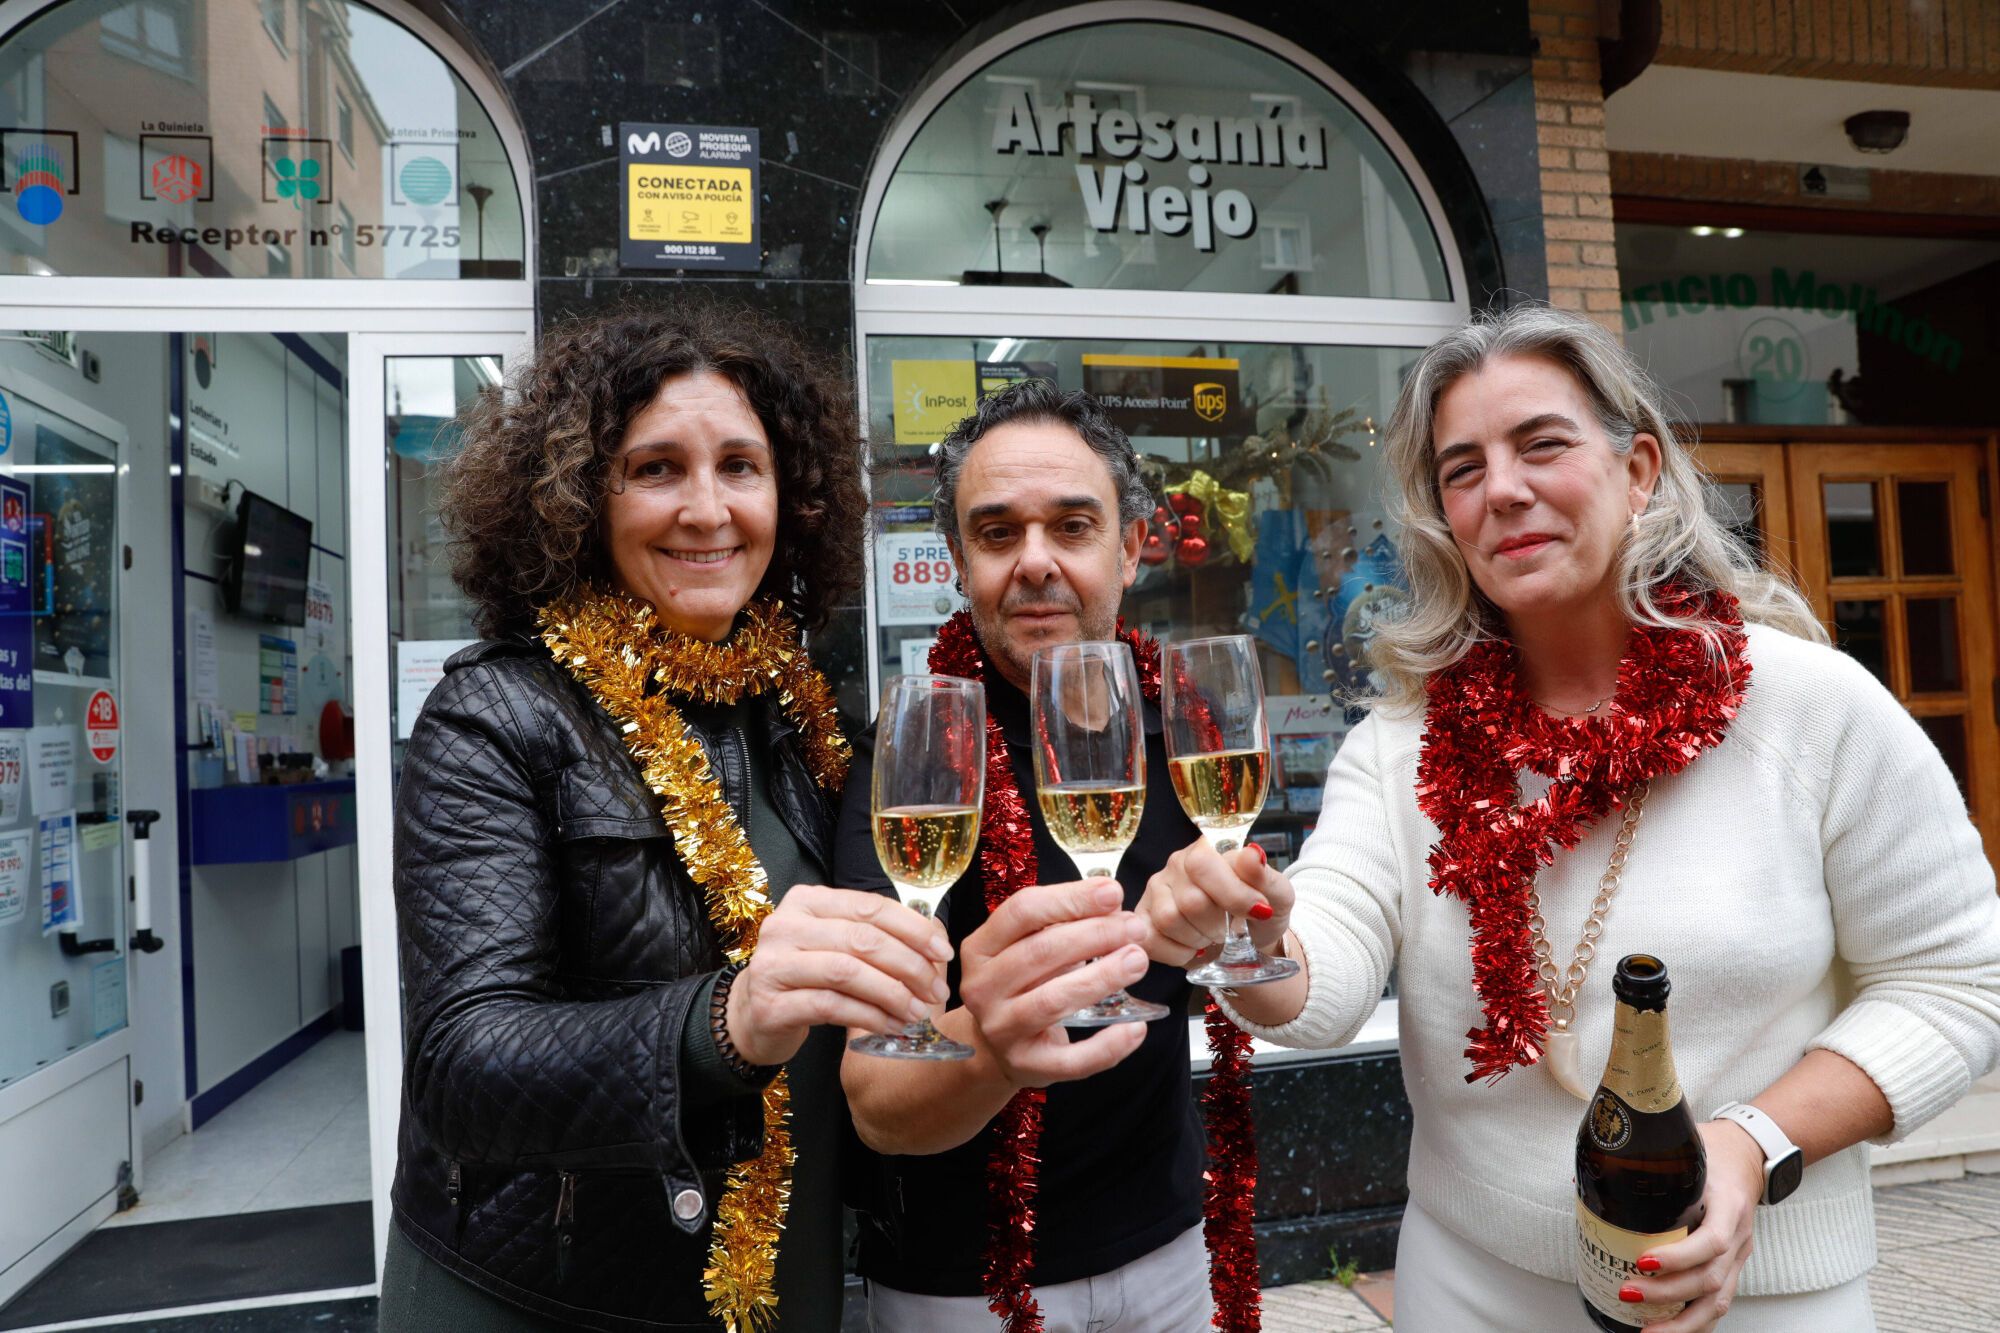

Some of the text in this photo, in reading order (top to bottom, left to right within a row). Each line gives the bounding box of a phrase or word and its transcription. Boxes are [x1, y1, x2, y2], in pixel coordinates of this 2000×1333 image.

[142, 121, 204, 132] La Quiniela
[431, 127, 477, 138] Primitiva
[993, 90, 1328, 170] Artesanía
[699, 133, 747, 143] MOVISTAR
[699, 142, 751, 153] PROSEGUR
[699, 150, 741, 160] ALARMAS
[637, 176, 743, 192] CONECTADA
[637, 191, 743, 203] CON AVISO A POLICÍA
[1075, 161, 1258, 252] Viejo
[131, 221, 298, 251] Receptor
[355, 224, 462, 249] 57725
[664, 245, 717, 256] 900 112 365
[1620, 272, 1758, 332] IFICIO
[1750, 335, 1802, 382] 20
[925, 393, 968, 409] InPost
[1099, 395, 1122, 408] UPS
[1124, 396, 1159, 409] Access
[1196, 395, 1224, 415] ups
[190, 442, 217, 467] Estado
[893, 561, 951, 585] 889
[16, 673, 31, 691] del
[92, 697, 113, 721] +18
[1593, 1258, 1631, 1281] EXTRA
